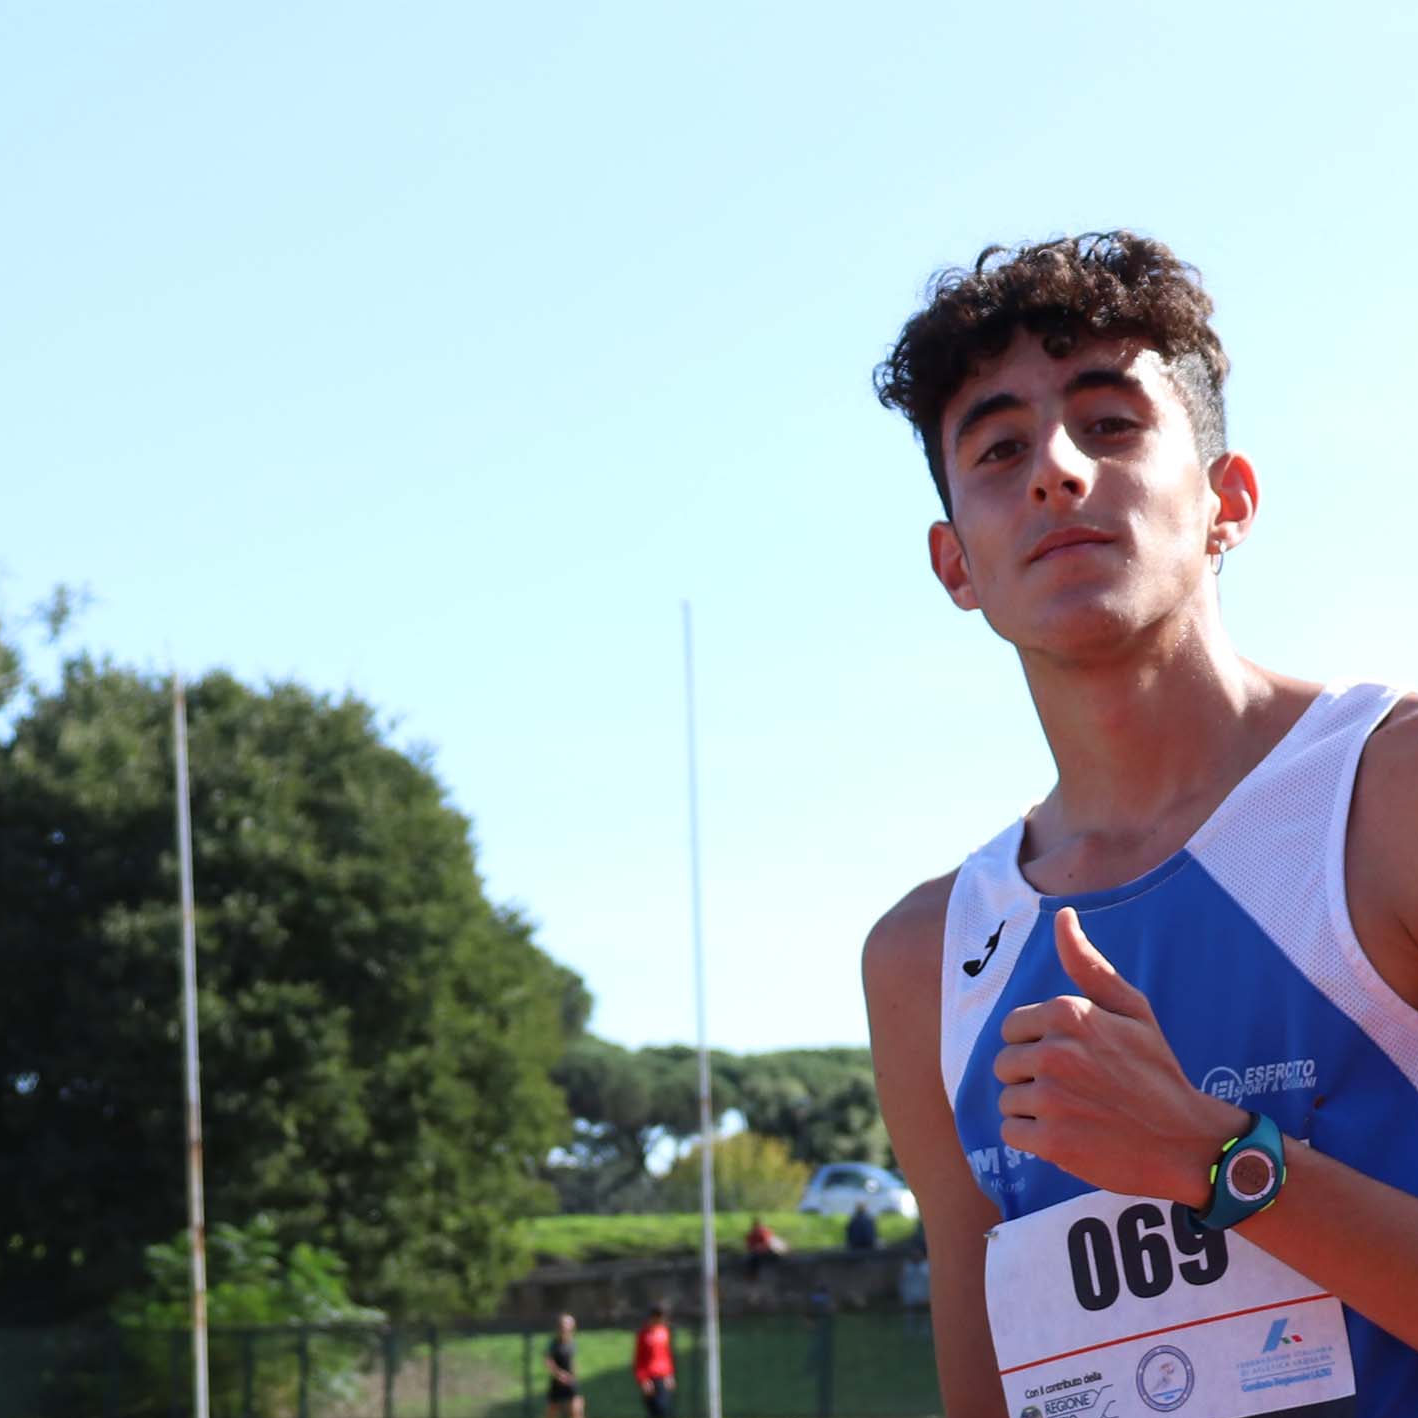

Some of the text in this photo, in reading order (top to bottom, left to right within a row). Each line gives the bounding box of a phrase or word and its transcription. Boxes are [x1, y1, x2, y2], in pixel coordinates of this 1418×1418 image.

[1244, 1059, 1316, 1085] ESERCITO
[1234, 1081, 1269, 1098] SPORT
[1025, 1388, 1040, 1399] Con
[1045, 1377, 1082, 1394] contributo
[1083, 1371, 1102, 1384] della
[1045, 1393, 1090, 1415] REGIONE
